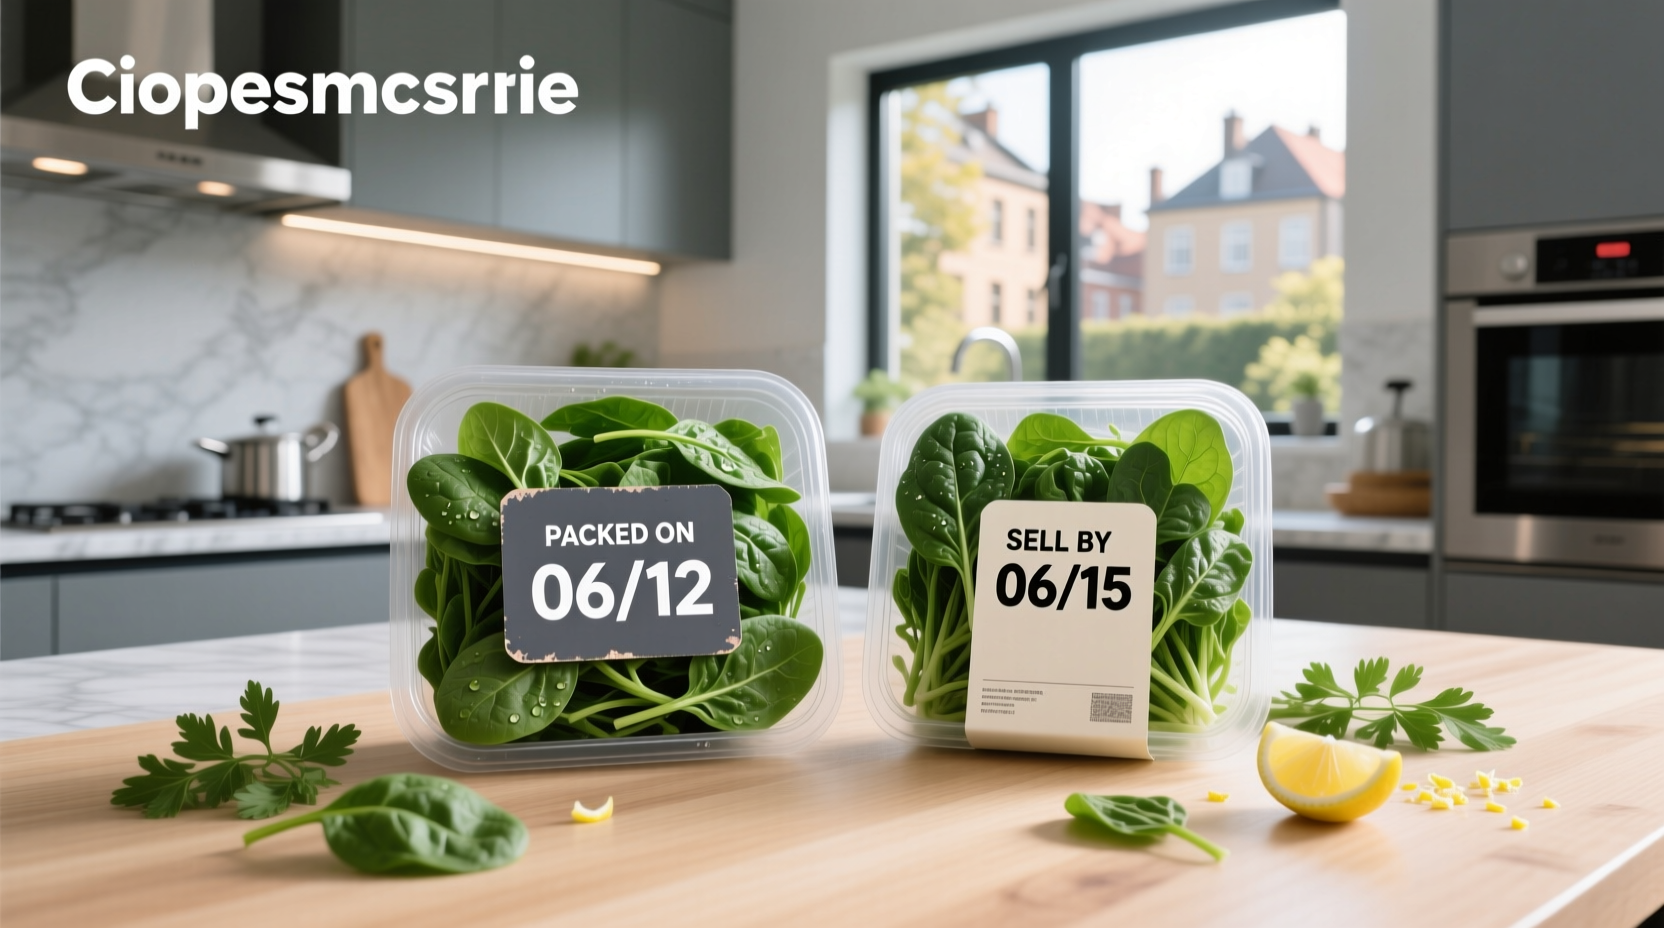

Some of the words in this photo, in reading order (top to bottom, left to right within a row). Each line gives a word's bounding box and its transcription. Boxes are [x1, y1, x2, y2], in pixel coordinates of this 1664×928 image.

[545, 522, 649, 547] PACKED
[655, 521, 695, 544] ON
[1006, 528, 1069, 553] SELL
[1077, 530, 1112, 554] BY
[531, 559, 714, 622] 06/12
[995, 563, 1132, 611] 06/15
